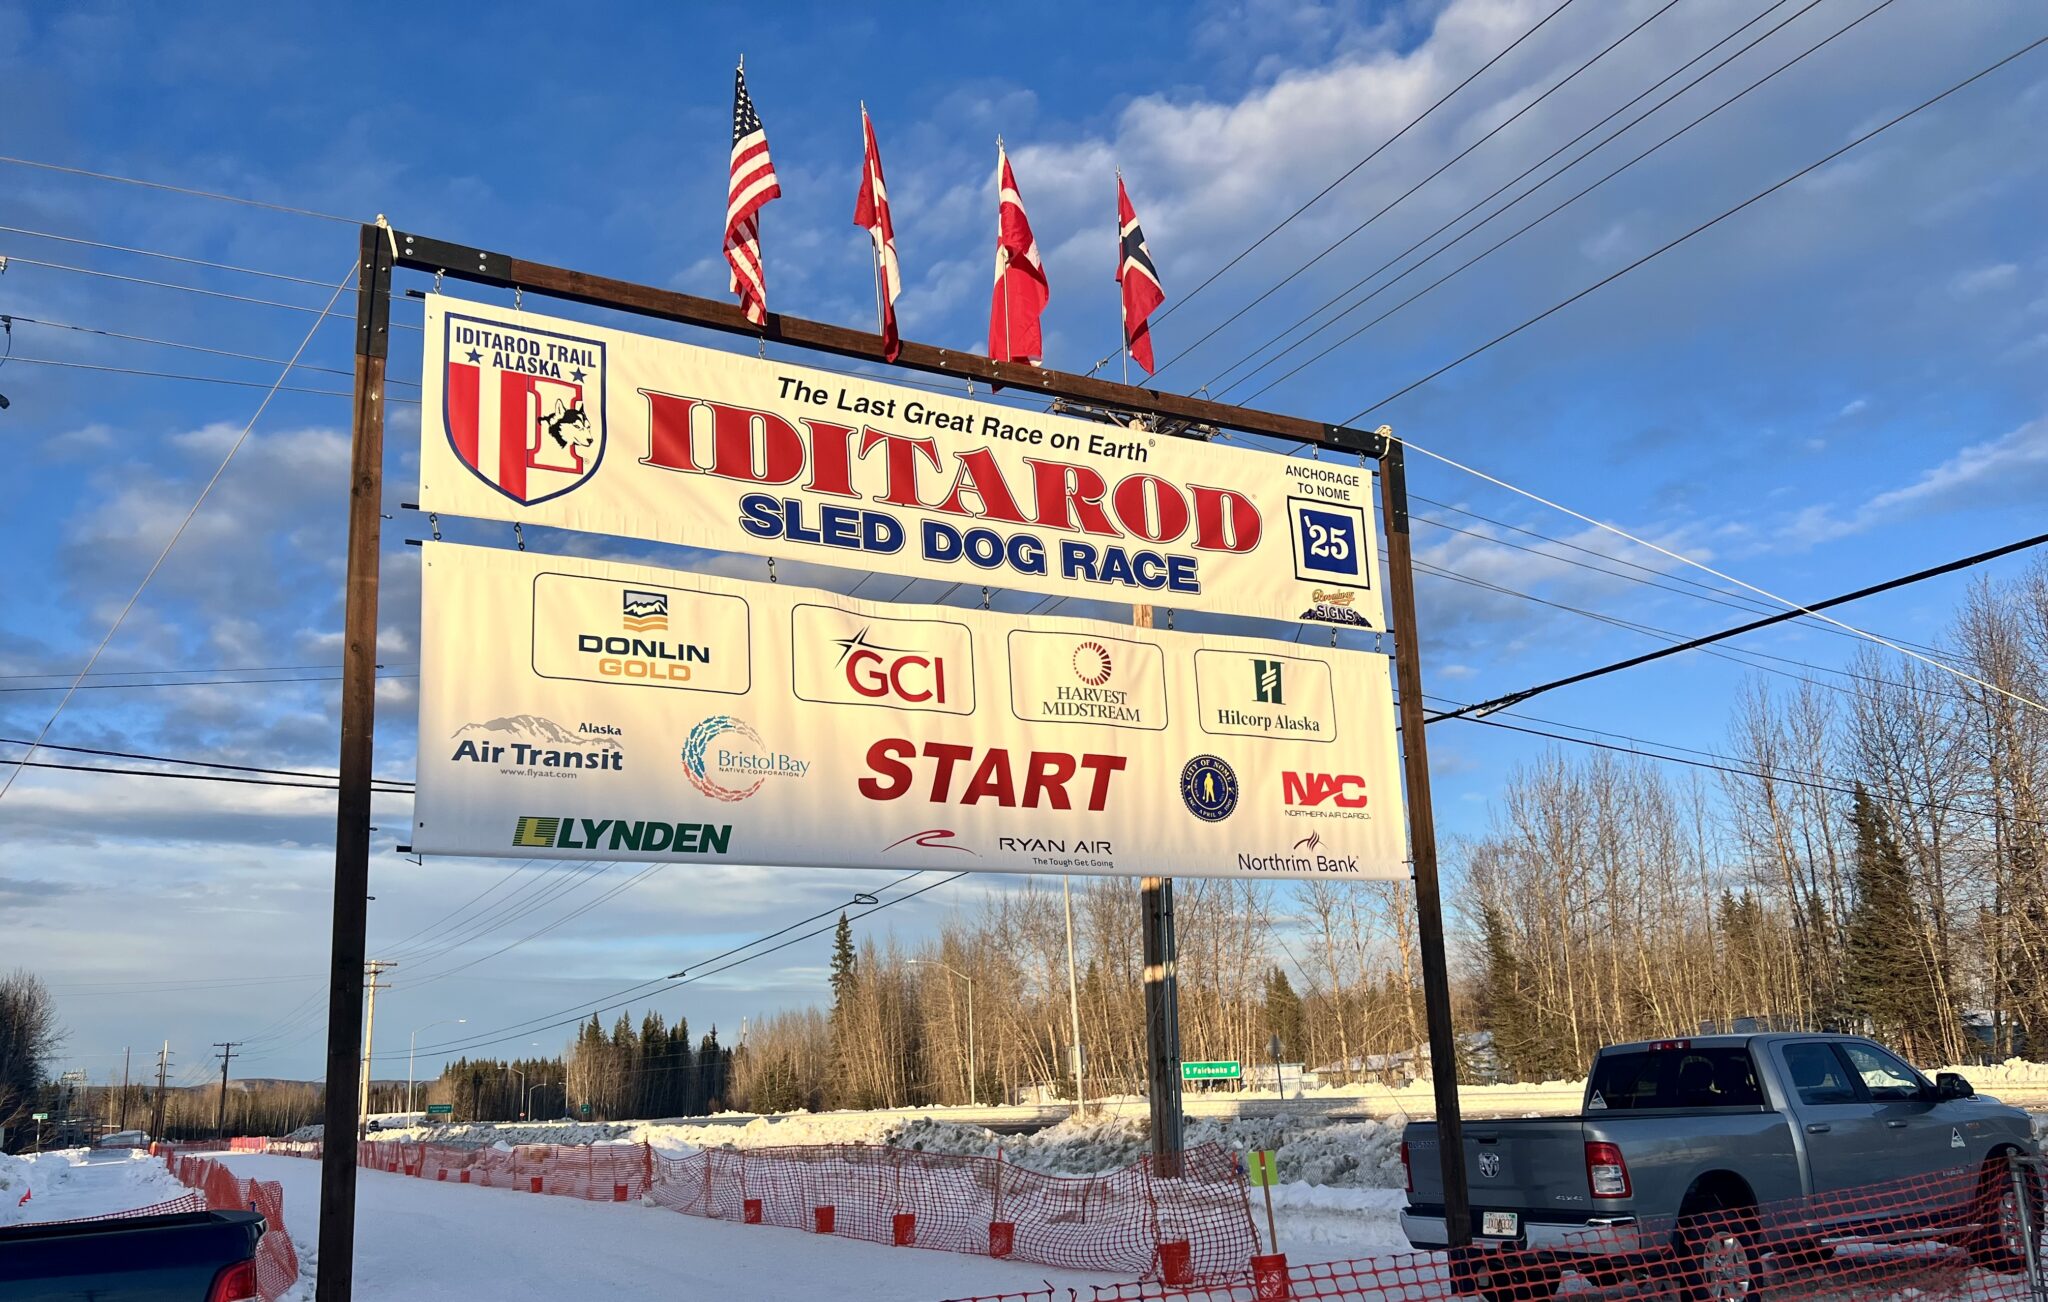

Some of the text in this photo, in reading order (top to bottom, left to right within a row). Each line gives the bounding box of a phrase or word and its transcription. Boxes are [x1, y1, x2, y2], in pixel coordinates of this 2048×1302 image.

[456, 326, 596, 368] IDITAROD TRAIL
[492, 351, 562, 378] ALASKA
[777, 376, 1148, 462] The Last Great Race on Earth
[637, 387, 1262, 554] IDITAROD
[1285, 464, 1359, 487] ANCHORAGE
[1297, 482, 1350, 501] TO NOME
[739, 493, 1201, 594] SLED DOG RACE
[1316, 603, 1355, 622] SIGNS
[578, 634, 710, 663] DONLIN
[599, 658, 691, 682] GOLD
[845, 649, 945, 704] GCI
[1057, 686, 1128, 705] HARVEST
[1042, 700, 1141, 723] MIDSTREAM
[1217, 709, 1320, 732] Hilcorp Alaska
[578, 722, 622, 736] Alaska
[452, 739, 623, 771] Air Transit
[719, 749, 811, 777] Bristol Bay
[500, 768, 578, 780] www.flyaat.com
[747, 769, 800, 778] CORPORATION
[858, 737, 1127, 811] START
[1185, 762, 1198, 781] CITY
[1213, 761, 1232, 783] NOME
[1282, 771, 1367, 808] NAC
[1199, 809, 1216, 818] APRIL
[1284, 809, 1327, 819] NORTHERN
[1328, 810, 1341, 819] AIR
[557, 817, 732, 855] LYNDEN
[1000, 837, 1113, 855] RYAN AIR
[1032, 857, 1113, 869] The Tough Get Going
[1238, 853, 1358, 872] Northrim Bank
[1193, 1066, 1227, 1074] Fairbanks
